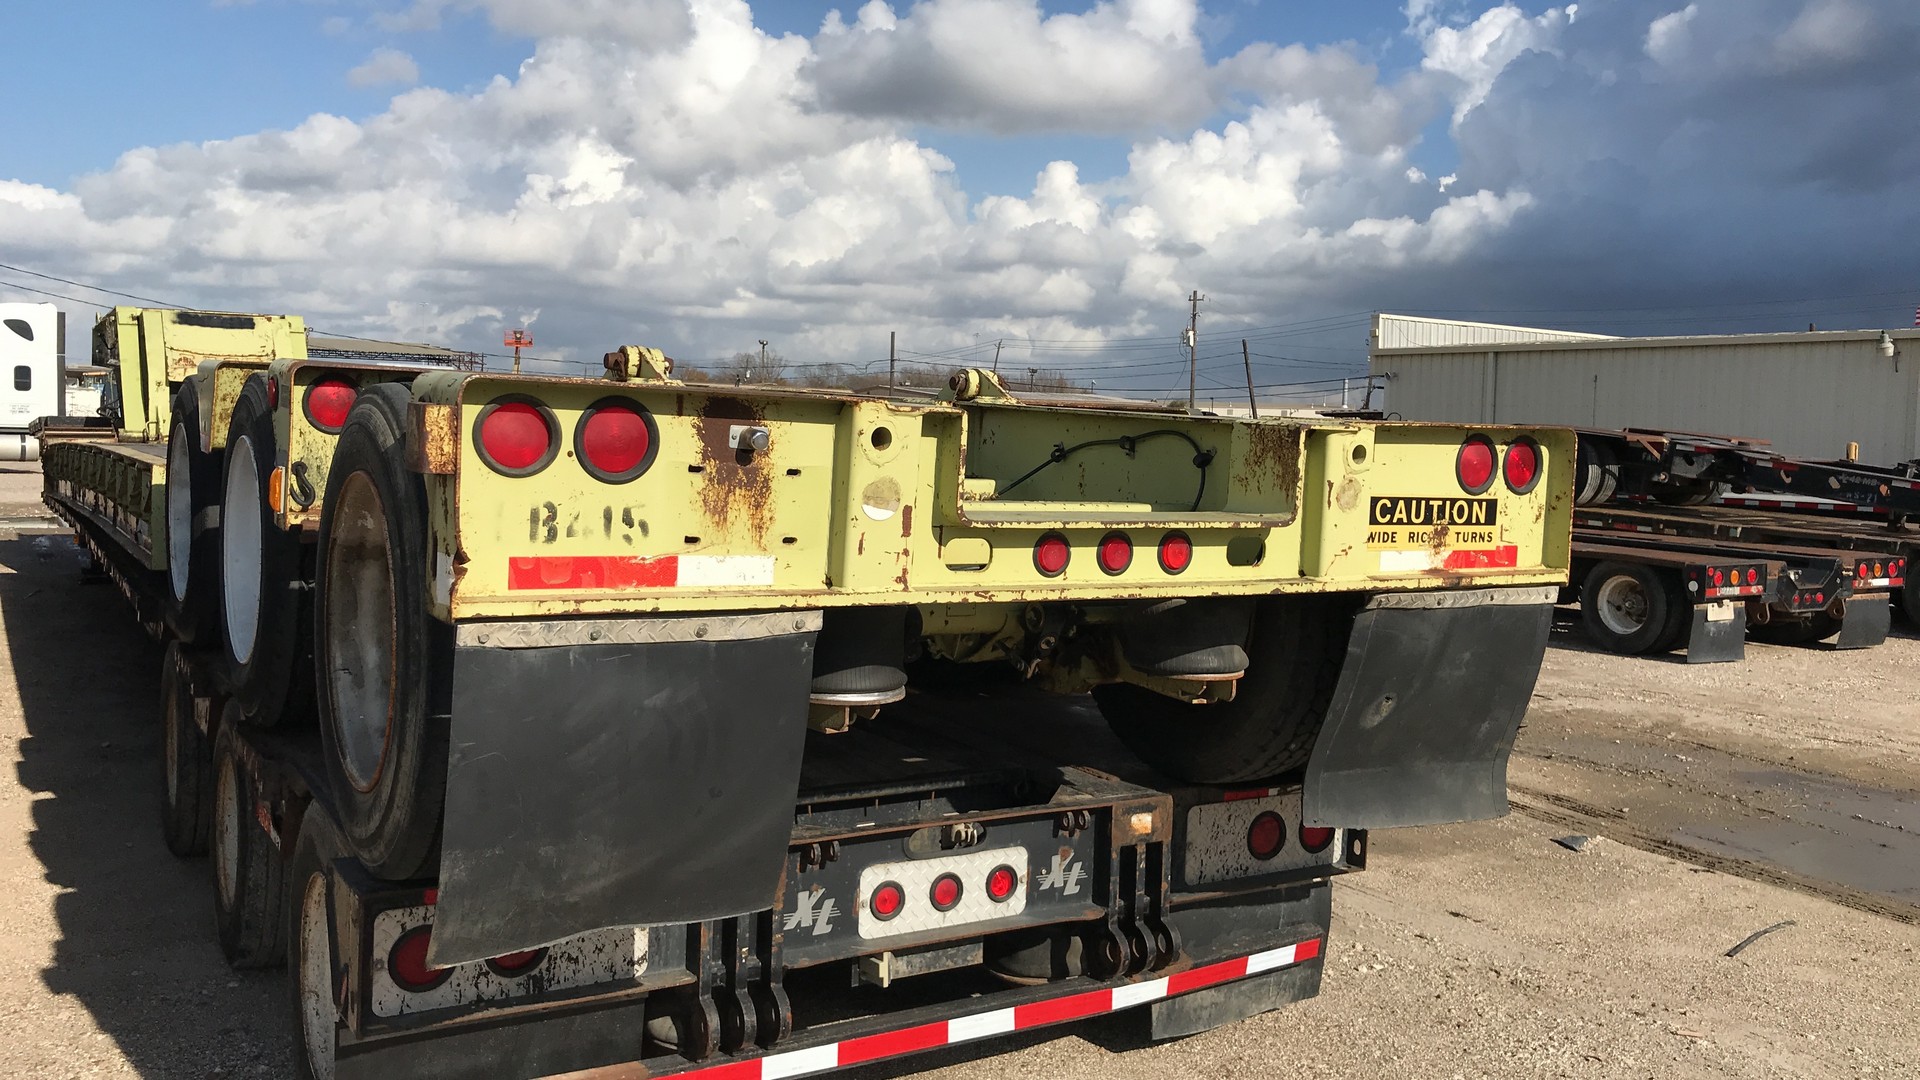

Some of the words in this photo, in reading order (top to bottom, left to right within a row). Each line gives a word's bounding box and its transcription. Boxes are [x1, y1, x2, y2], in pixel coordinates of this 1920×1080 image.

[1375, 498, 1487, 524] CAUTION
[1367, 531, 1398, 544] WIDE
[1408, 531, 1446, 544] RIG
[1455, 531, 1494, 544] TURNS
[1036, 849, 1088, 896] XL
[783, 887, 842, 936] XL
